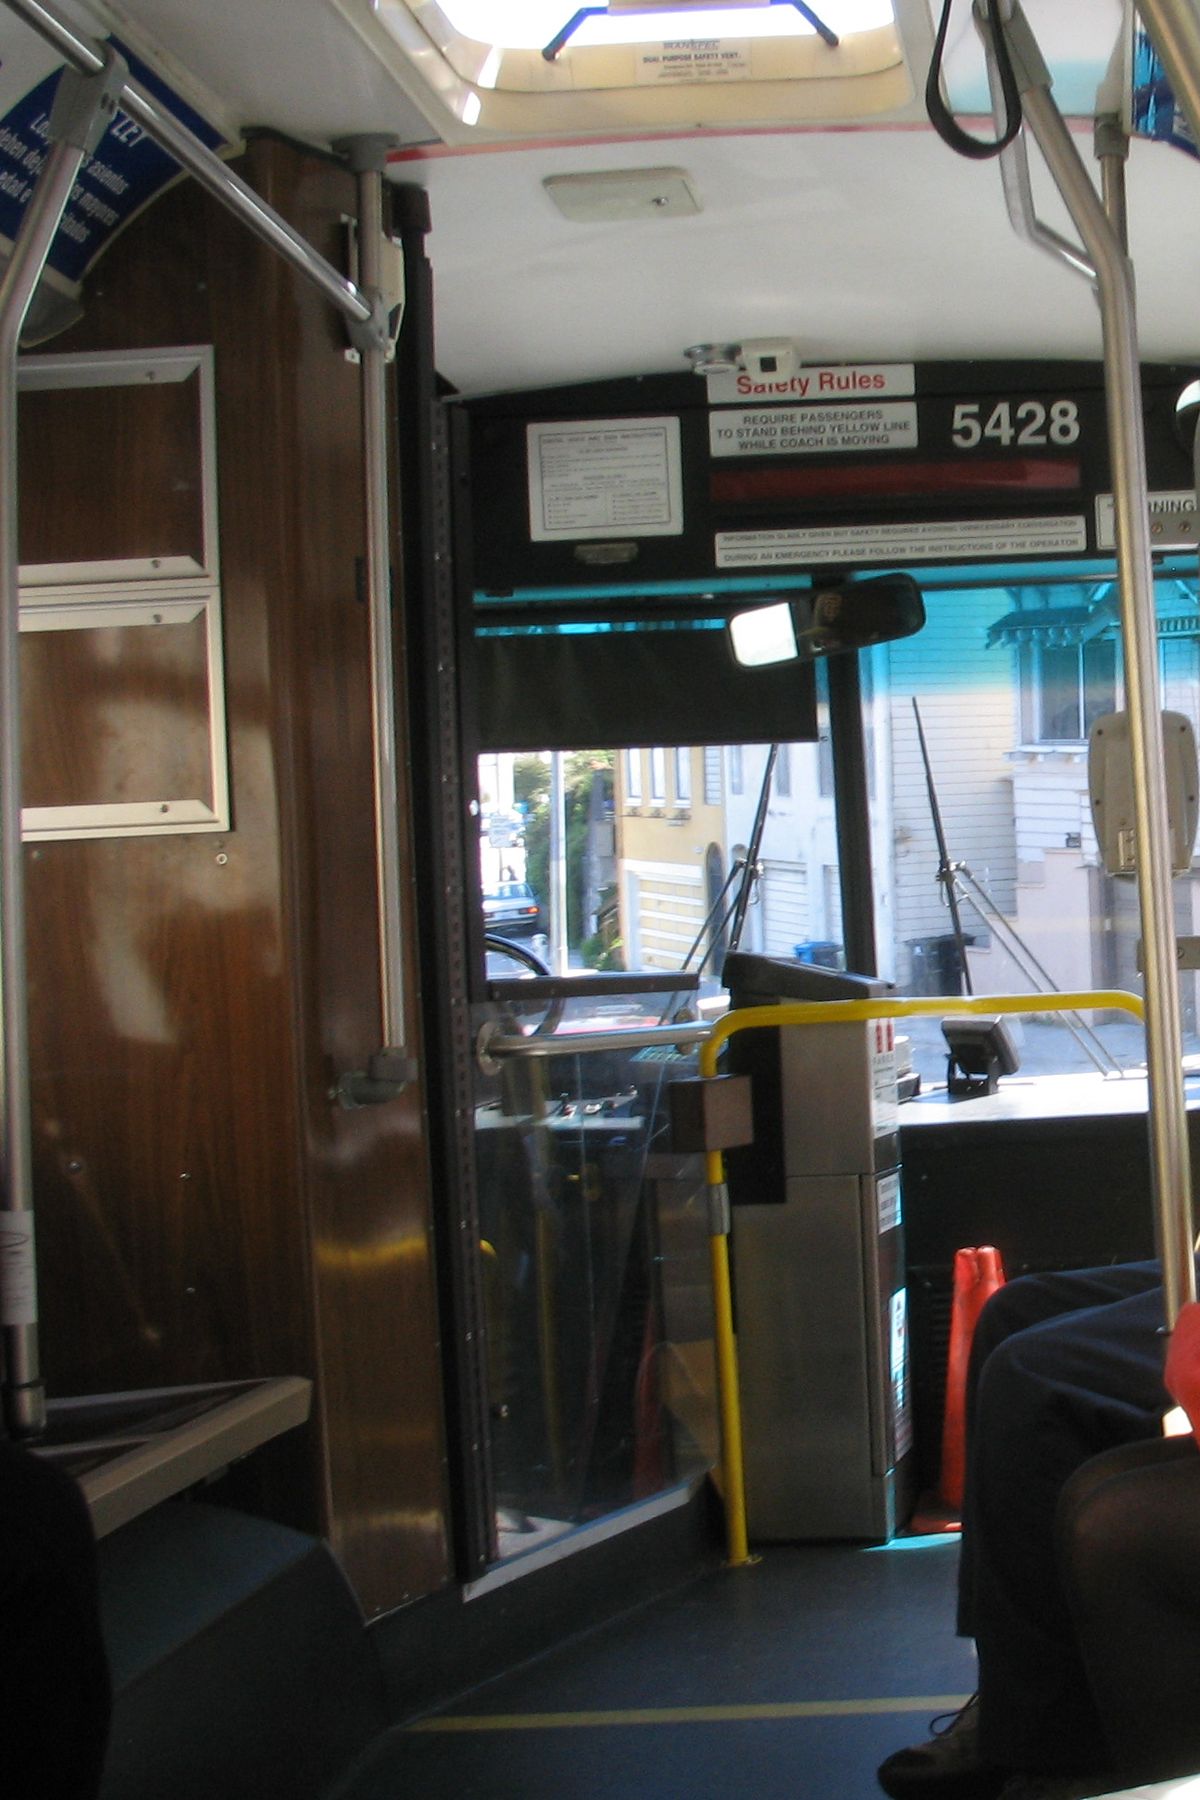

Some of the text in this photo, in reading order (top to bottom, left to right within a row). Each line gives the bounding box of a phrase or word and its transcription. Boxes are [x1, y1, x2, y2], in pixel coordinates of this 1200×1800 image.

[819, 371, 886, 391] Rules
[743, 409, 884, 425] REQUIRE PASSENGERS
[951, 400, 1081, 449] 5428
[717, 420, 911, 439] TO STAND BEHIND YELLOW LINE
[738, 433, 890, 450] WHILE COACH IS MOVING
[1148, 498, 1195, 514] NING
[724, 553, 757, 562] DURING
[760, 552, 773, 560] AN
[775, 550, 830, 560] EMERGENCY
[832, 548, 866, 558] PLEASE
[869, 545, 906, 555] FOLLOW
[909, 544, 926, 553] THE
[928, 541, 993, 552] INSTRUCTIONS
[1010, 540, 1026, 549] THE
[1030, 538, 1079, 549] OPERATOR
